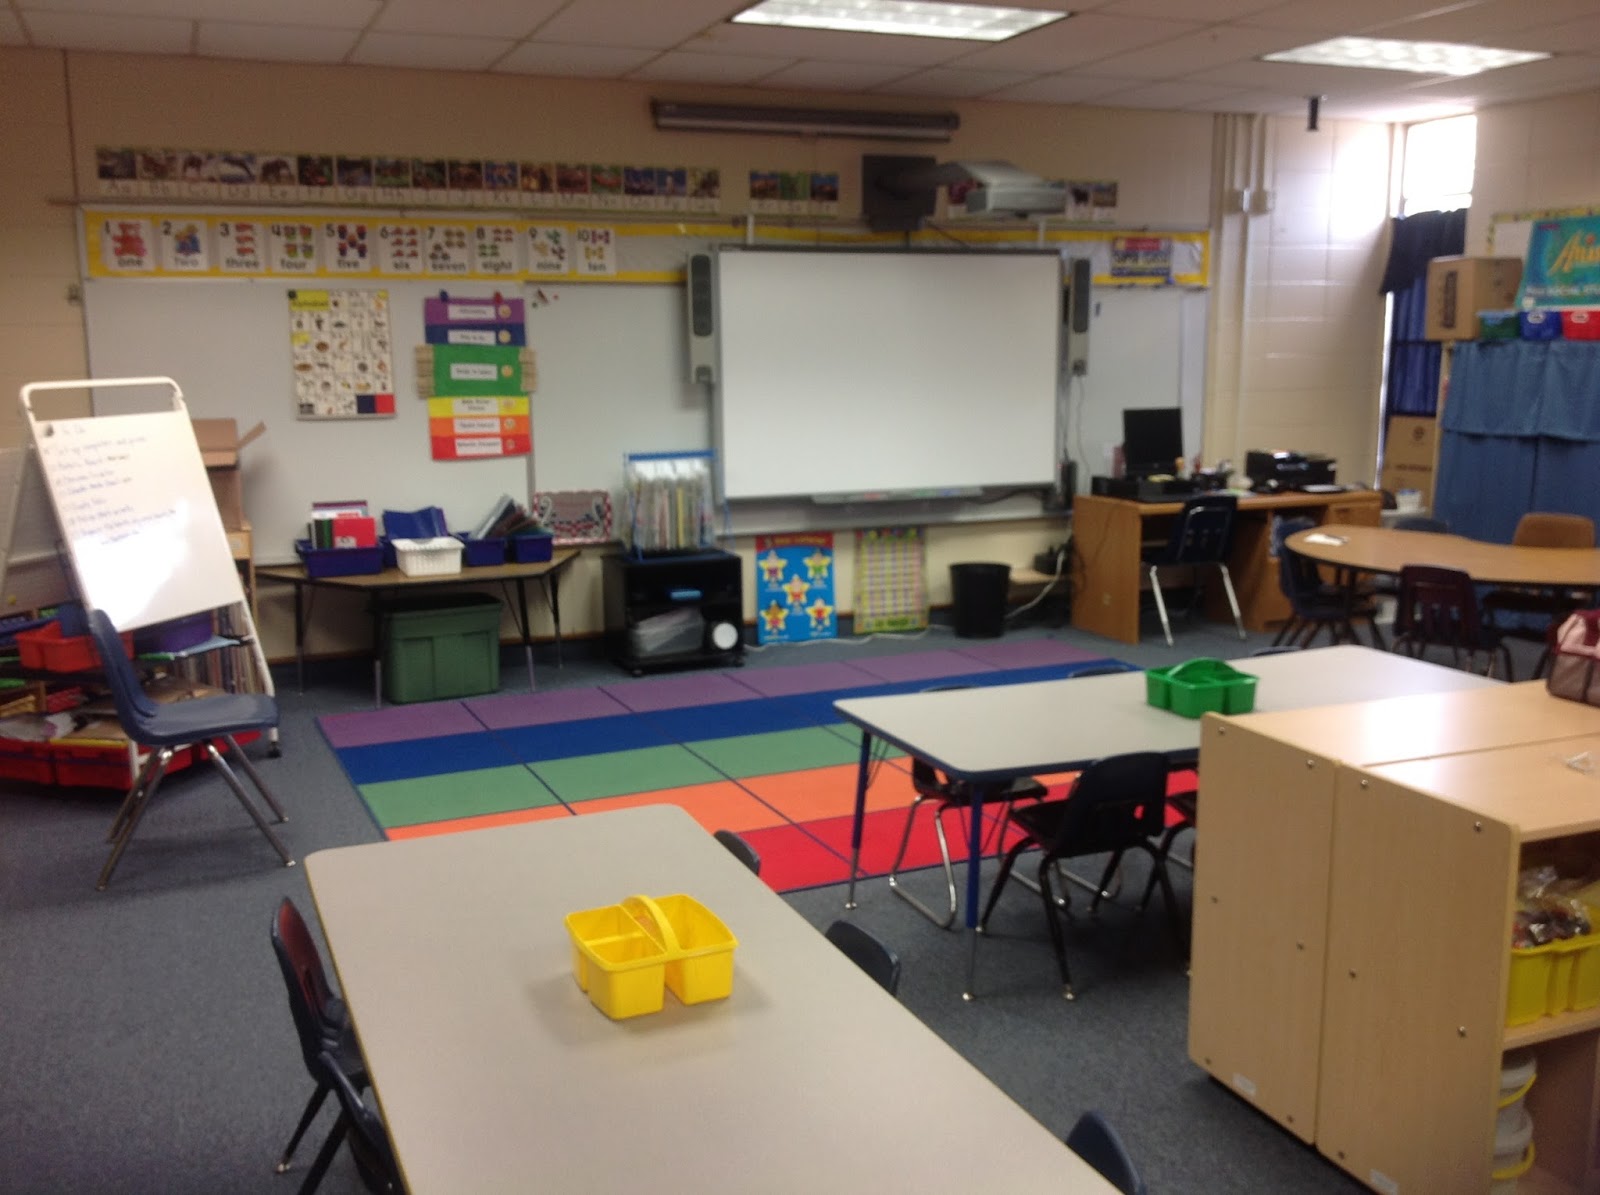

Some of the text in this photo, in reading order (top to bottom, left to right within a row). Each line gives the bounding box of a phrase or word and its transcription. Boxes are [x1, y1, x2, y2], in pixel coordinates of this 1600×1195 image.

[105, 220, 111, 235] 1
[161, 219, 172, 236] 2
[219, 221, 230, 237] 3
[271, 223, 281, 237] 4
[325, 222, 336, 238] 5
[379, 225, 389, 239] 6
[427, 225, 436, 240] 7
[476, 226, 486, 240] 8
[528, 226, 538, 240] 9
[577, 229, 590, 242] 10
[117, 257, 144, 268] one
[225, 256, 260, 269] three
[280, 258, 307, 270] four
[337, 259, 361, 269] five
[392, 259, 411, 271] six
[431, 260, 467, 272] seven
[482, 260, 513, 275] eight
[536, 260, 562, 272] nine
[588, 261, 607, 272] ten
